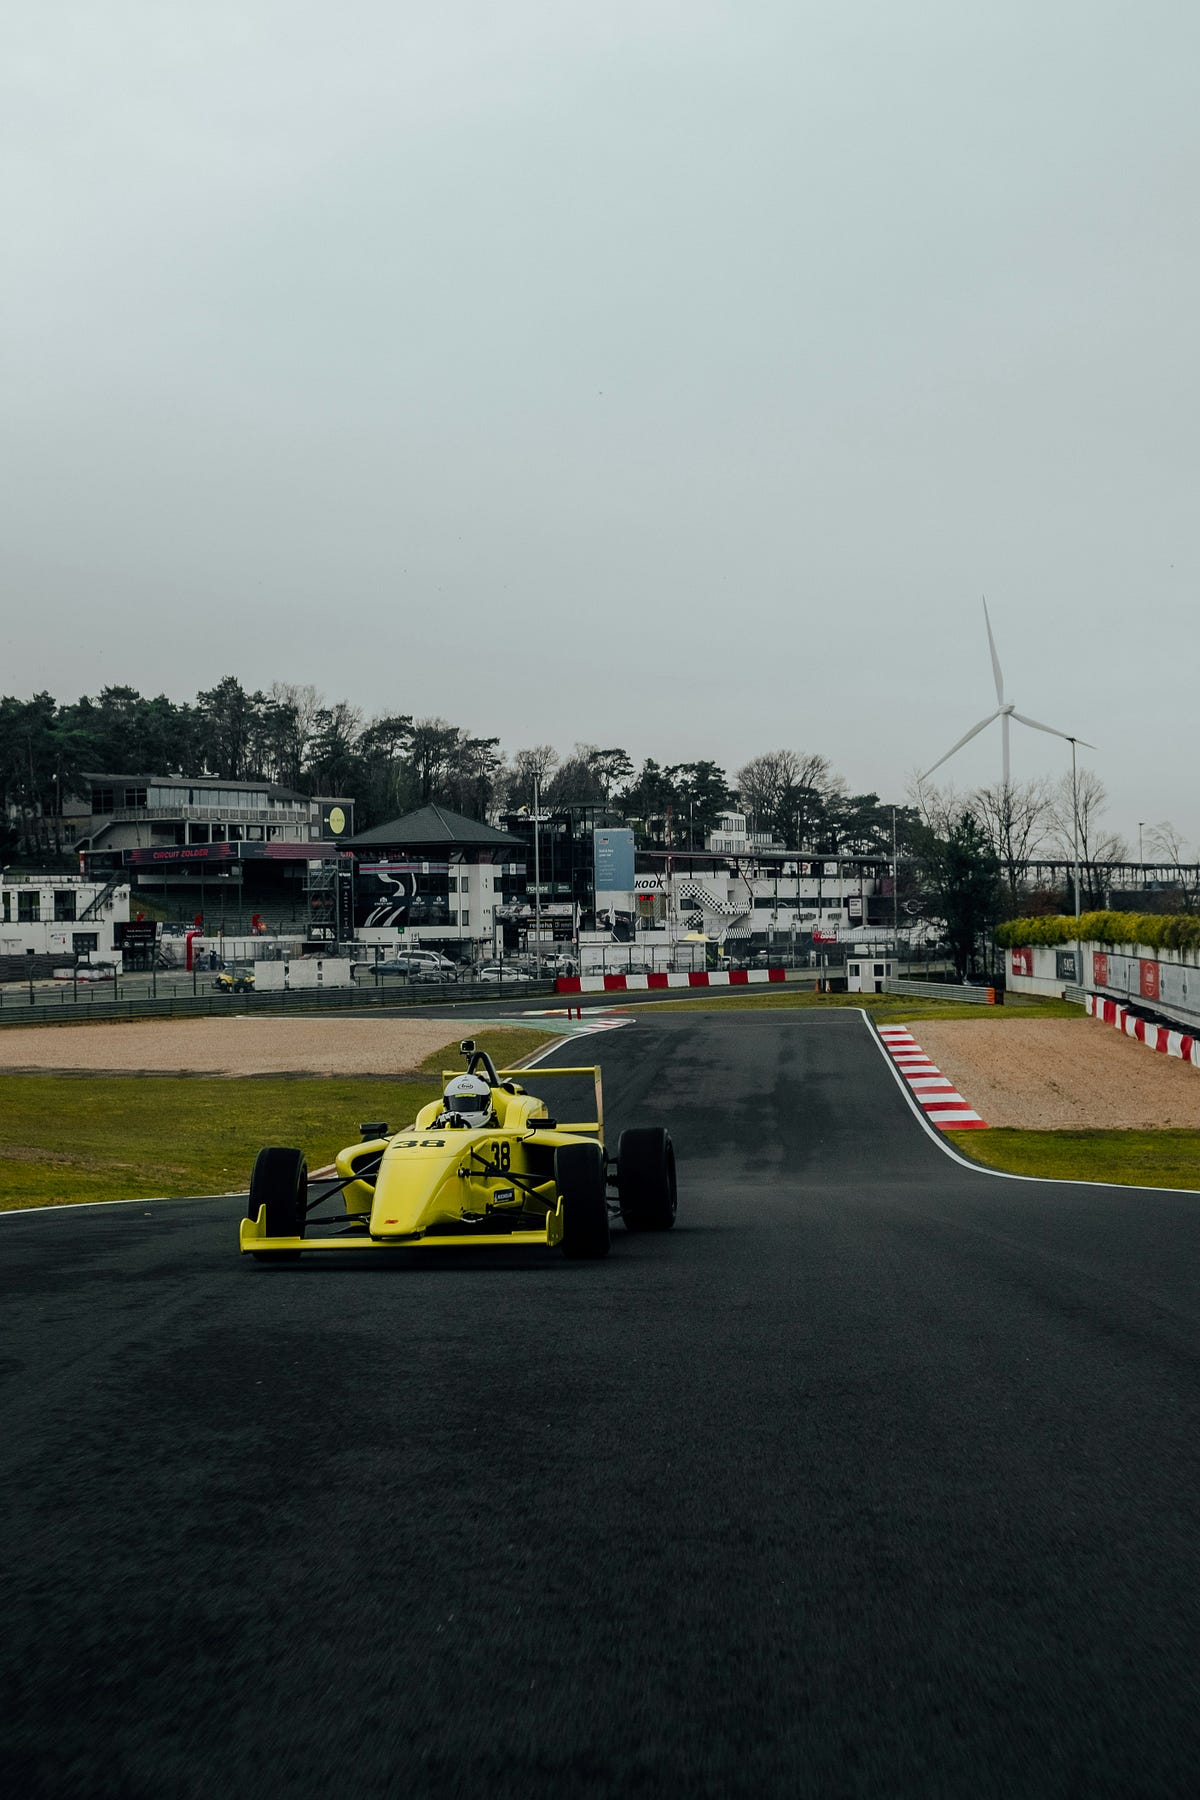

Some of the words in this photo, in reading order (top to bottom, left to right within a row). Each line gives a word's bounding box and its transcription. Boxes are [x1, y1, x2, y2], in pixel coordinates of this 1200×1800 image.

[153, 851, 179, 859] CIRCUIT
[181, 848, 209, 857] ZOLDER
[635, 880, 663, 888] KOOK
[392, 1139, 446, 1149] 38
[491, 1141, 511, 1172] 38
